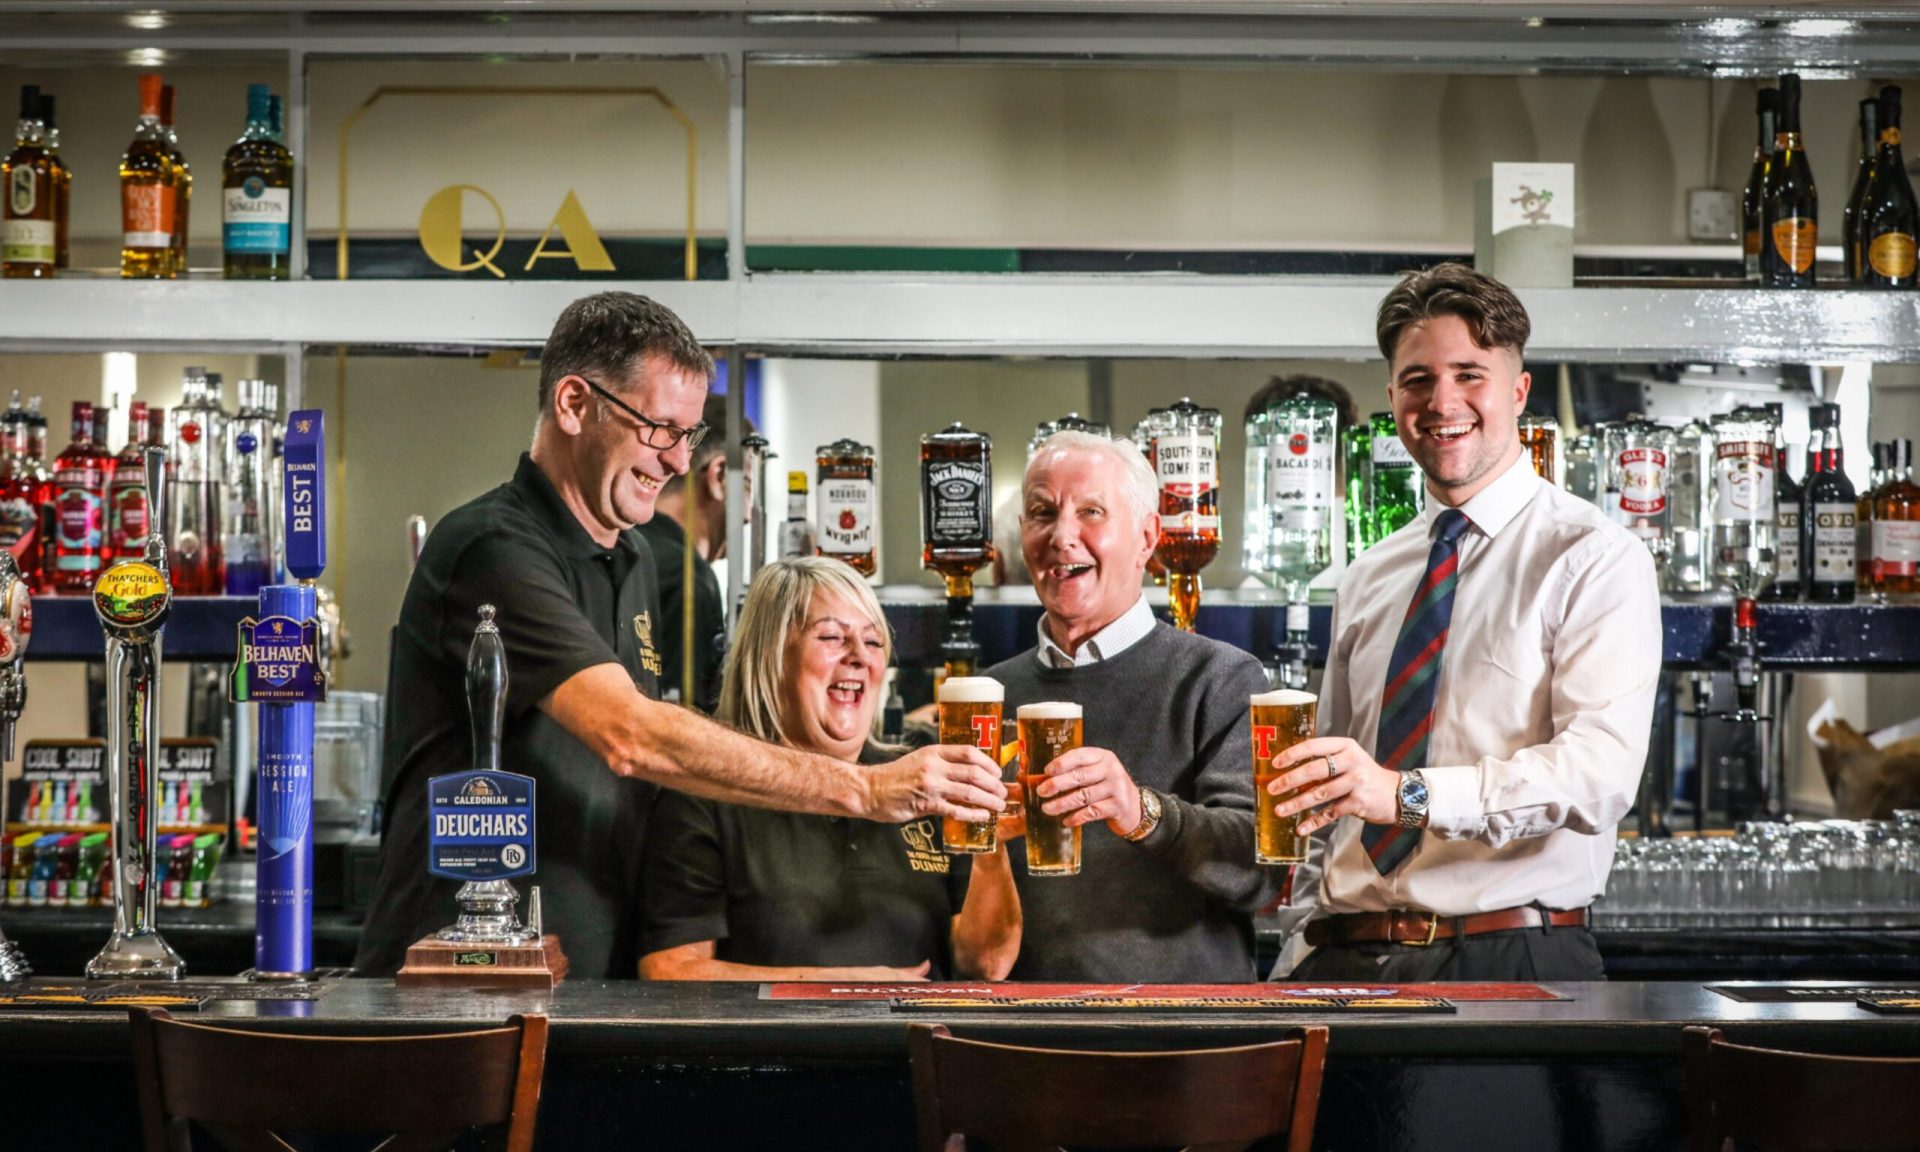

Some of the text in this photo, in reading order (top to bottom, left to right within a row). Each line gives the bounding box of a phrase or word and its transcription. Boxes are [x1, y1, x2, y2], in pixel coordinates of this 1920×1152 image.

[1159, 445, 1212, 460] SOUTHRN
[287, 463, 316, 472] BELHAVEN
[1162, 462, 1210, 475] COMFRT
[292, 475, 312, 532] BEST
[107, 574, 159, 584] THATCHERS
[113, 583, 147, 597] Gold
[243, 644, 314, 664] BELHAVEN
[257, 664, 300, 679] BEST
[972, 716, 997, 749] T
[1254, 726, 1277, 760] T
[454, 796, 508, 805] CALEDONIAN
[435, 814, 528, 837] DEUCHARS
